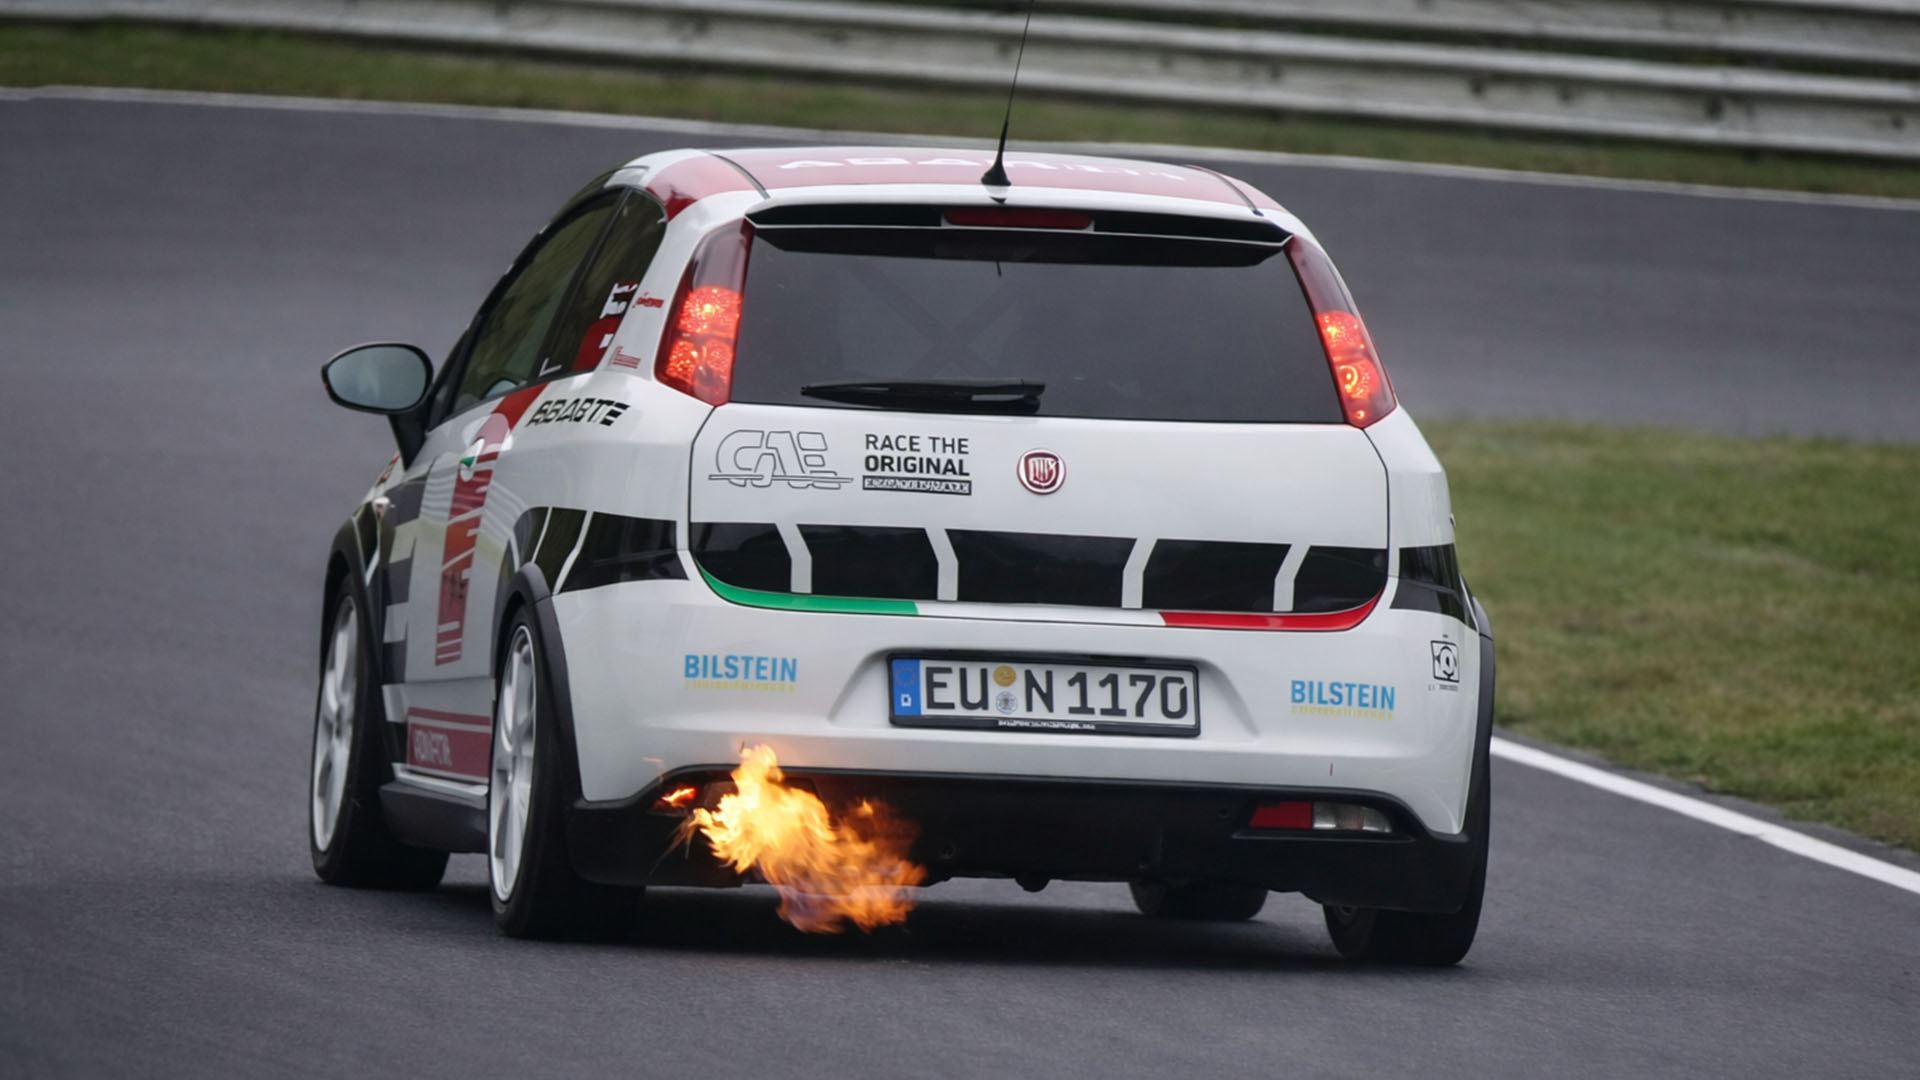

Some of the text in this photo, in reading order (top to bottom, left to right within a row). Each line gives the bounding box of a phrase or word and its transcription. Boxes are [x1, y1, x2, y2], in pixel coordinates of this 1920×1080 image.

[865, 433, 969, 454] RACE THE
[865, 454, 970, 476] ORIGINAL
[684, 654, 798, 682] BILSTEIN
[925, 666, 1188, 720] EU N 1170
[1291, 680, 1395, 711] BILSTEIN
